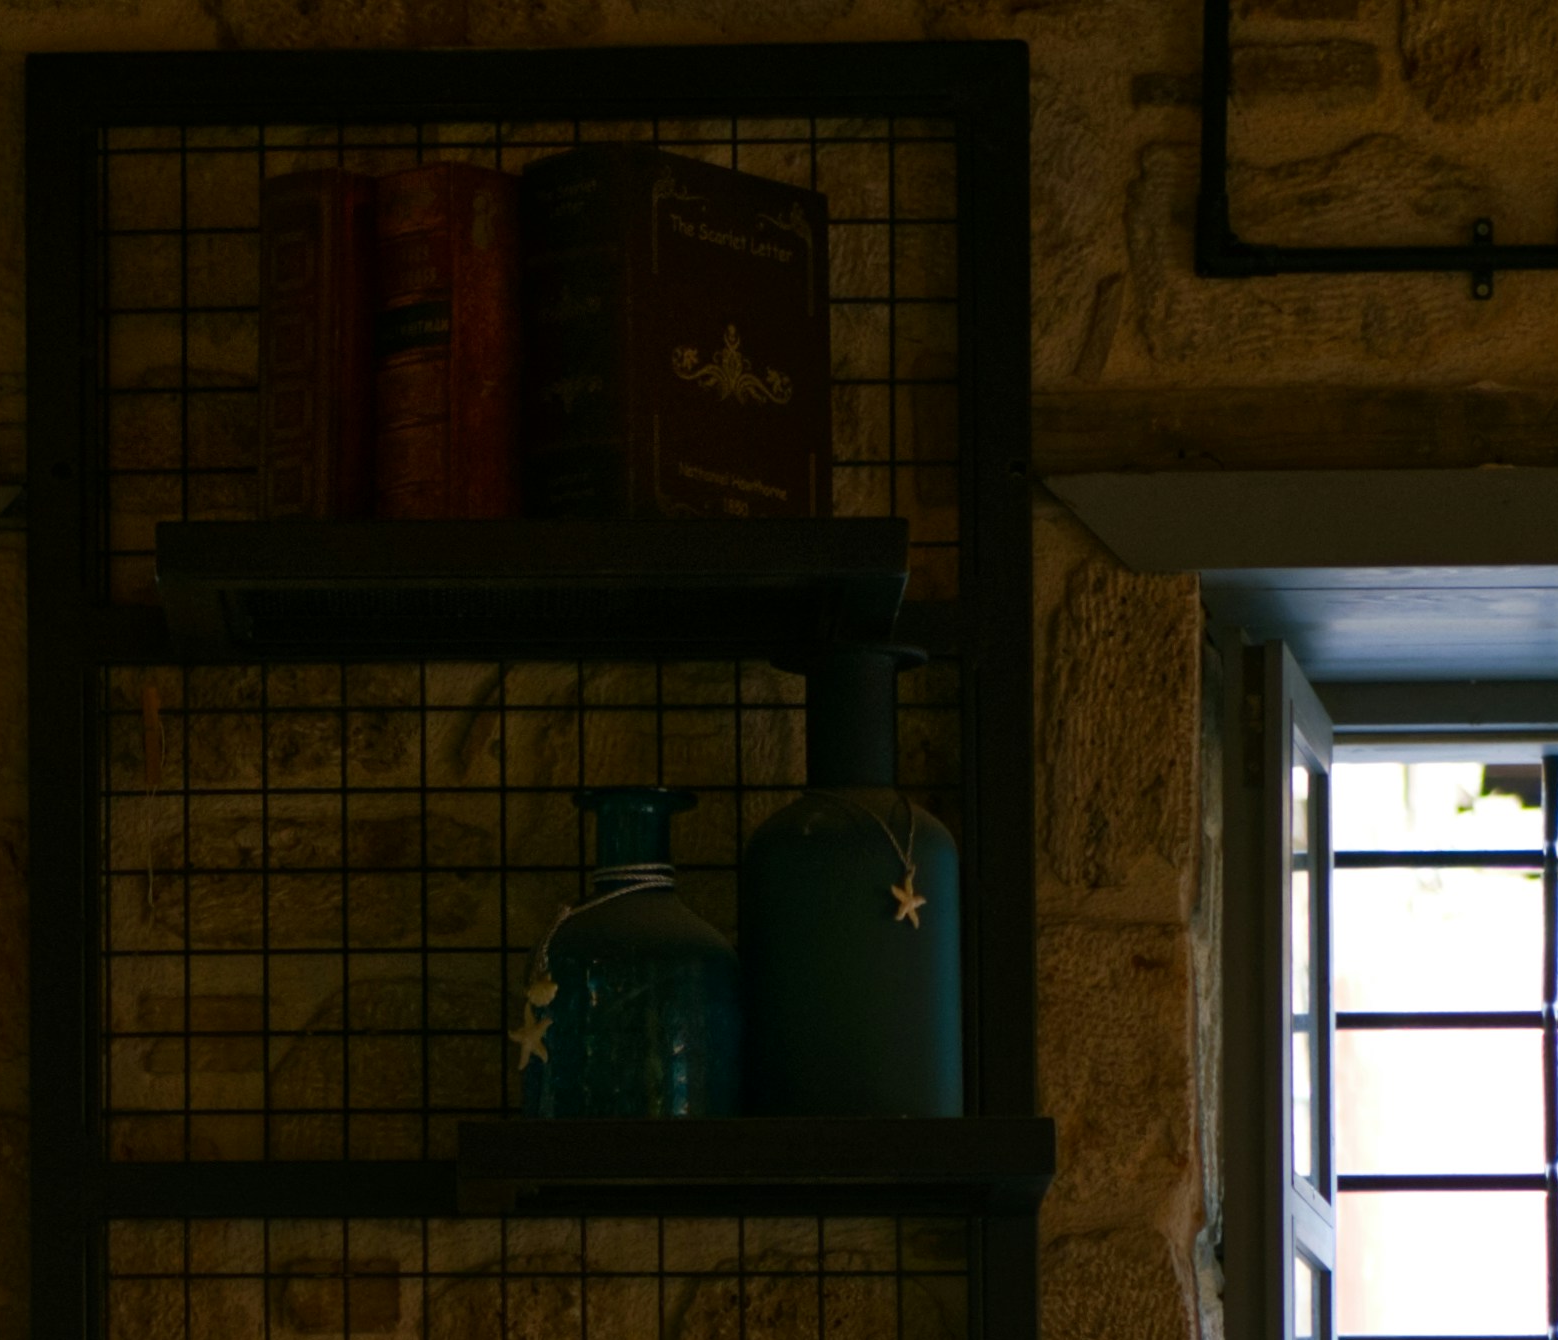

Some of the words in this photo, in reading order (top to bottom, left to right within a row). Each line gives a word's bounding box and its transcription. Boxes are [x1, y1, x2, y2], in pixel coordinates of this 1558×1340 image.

[669, 213, 695, 237] The
[698, 222, 747, 251] Scarlet
[750, 236, 793, 263] Letter
